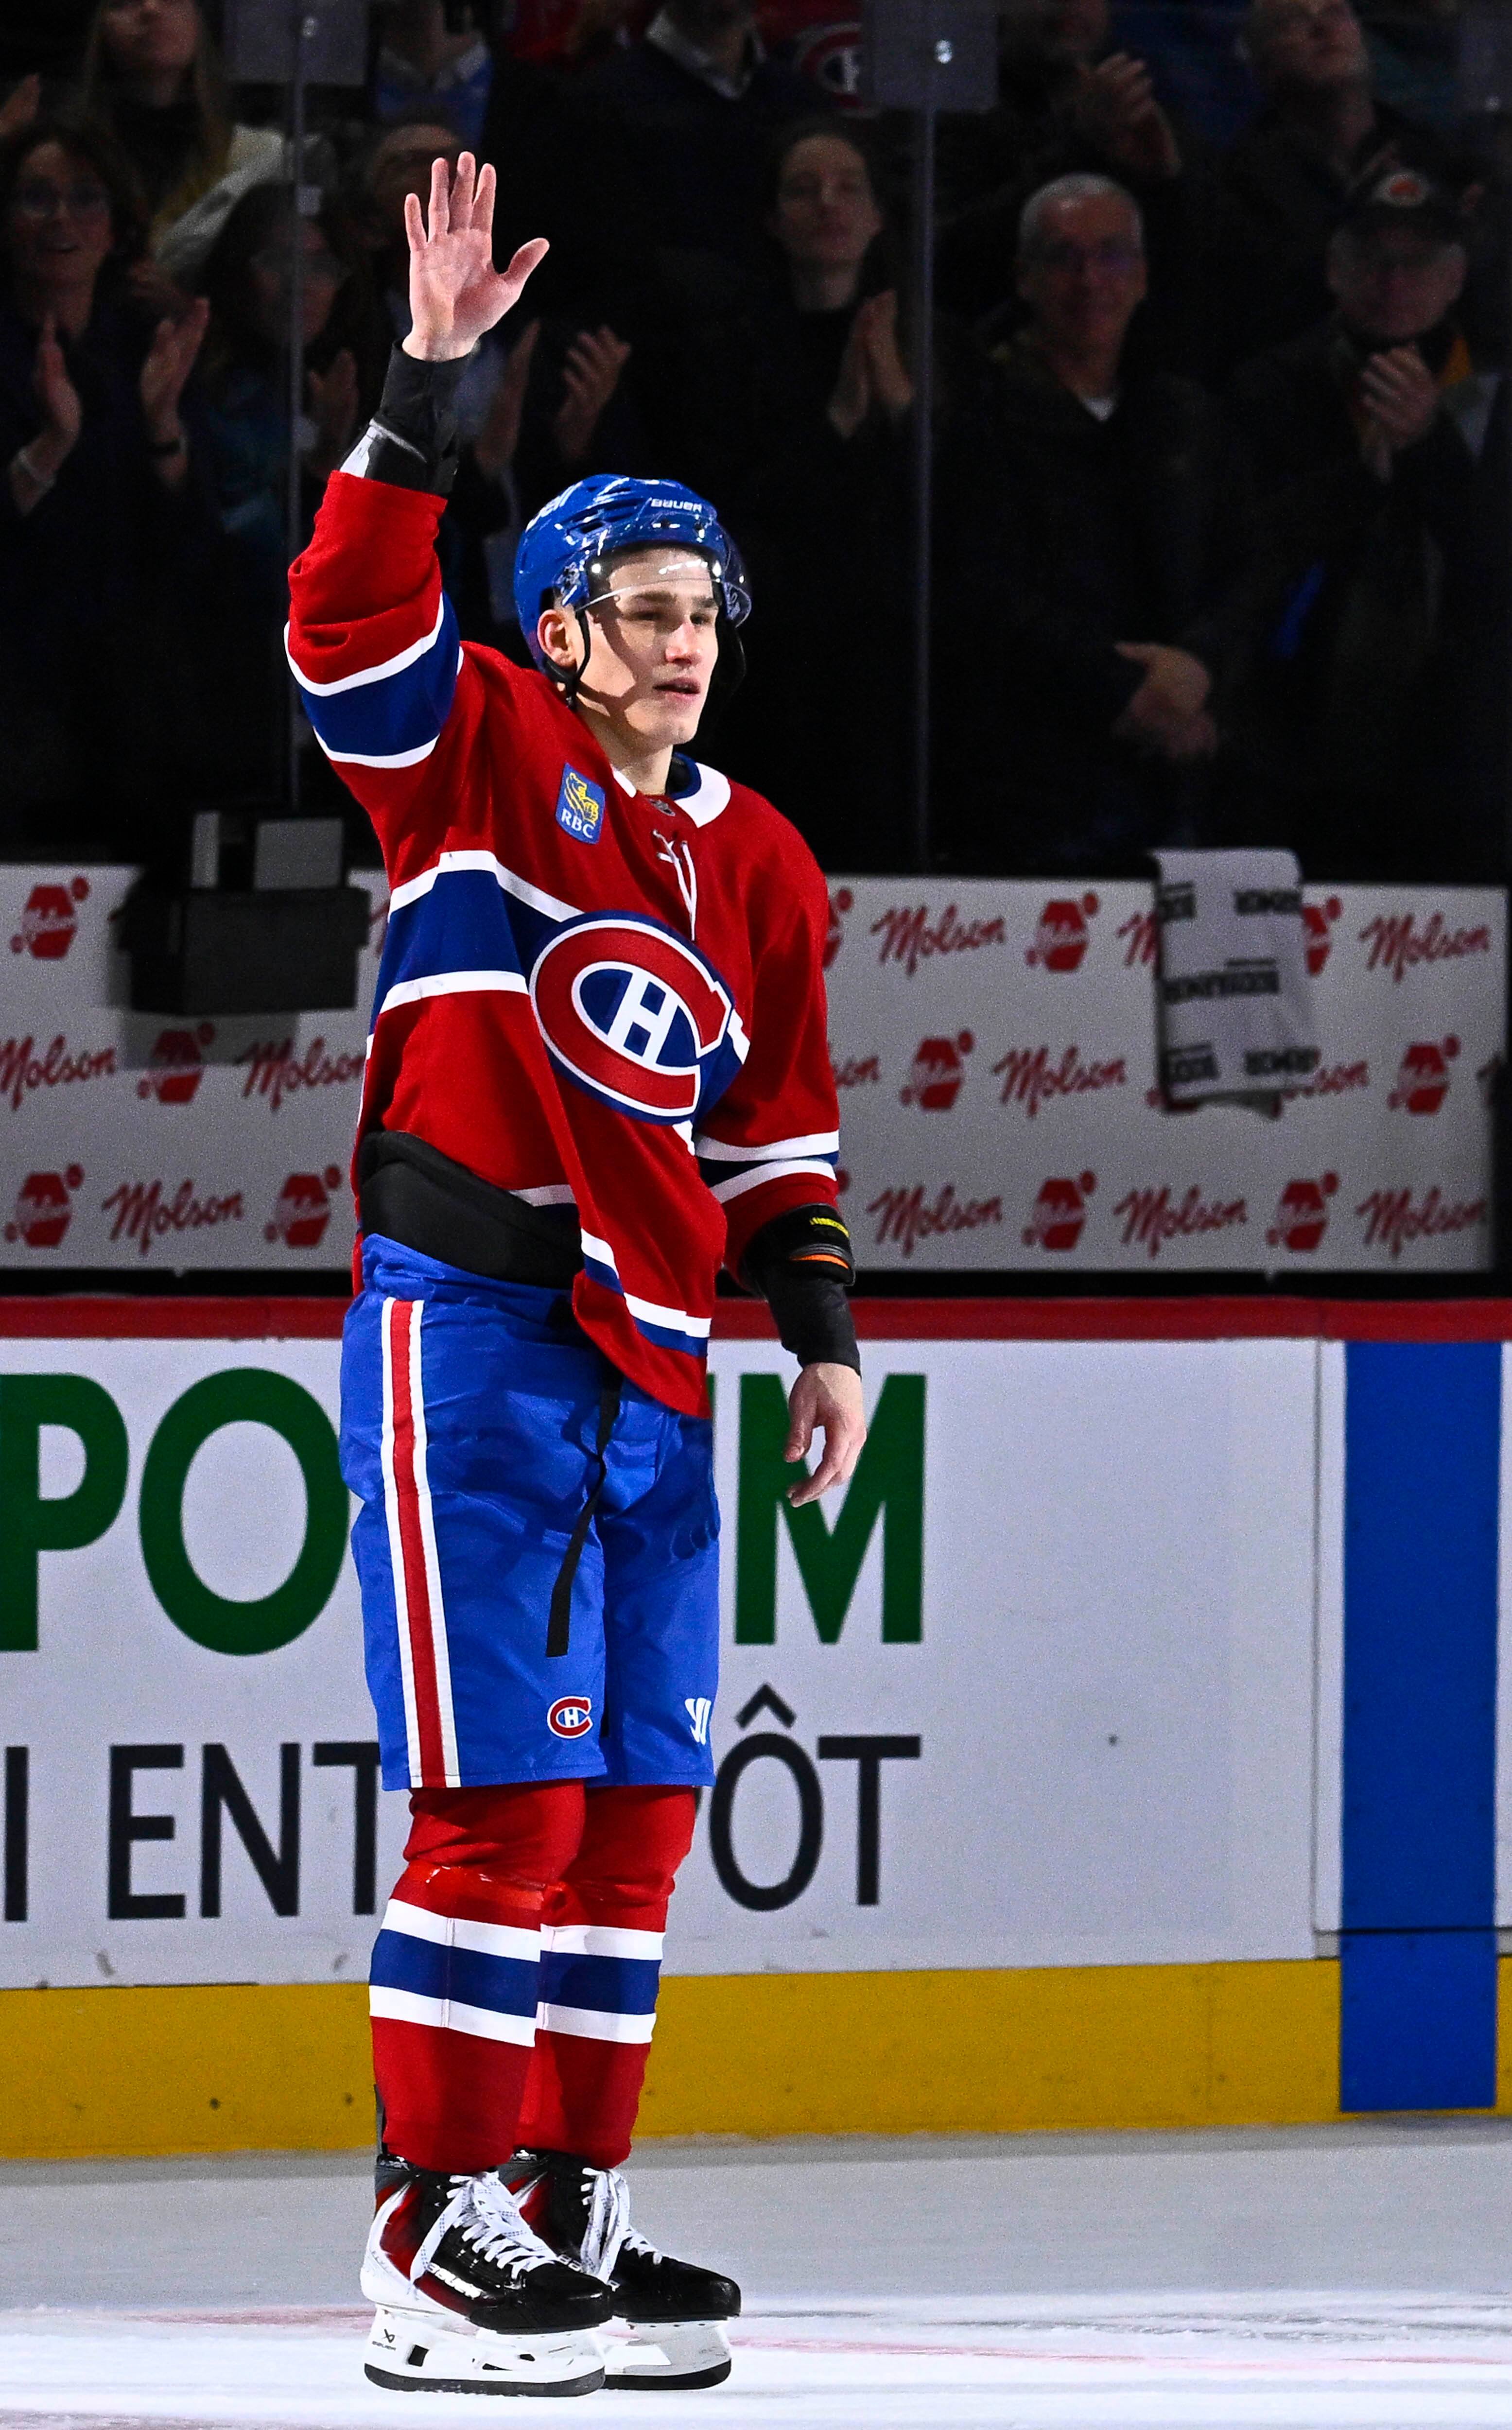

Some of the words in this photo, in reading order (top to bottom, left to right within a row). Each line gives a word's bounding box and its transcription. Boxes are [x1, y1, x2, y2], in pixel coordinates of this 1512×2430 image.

[561, 808, 594, 839] RBC
[872, 904, 1004, 973] Molson
[1362, 913, 1489, 982] Molson
[994, 1046, 1125, 1116] Molson
[103, 1178, 244, 1255] Molson
[868, 1185, 1002, 1255] Molson
[1113, 1186, 1247, 1257] Molson
[1356, 1187, 1486, 1256] Molson
